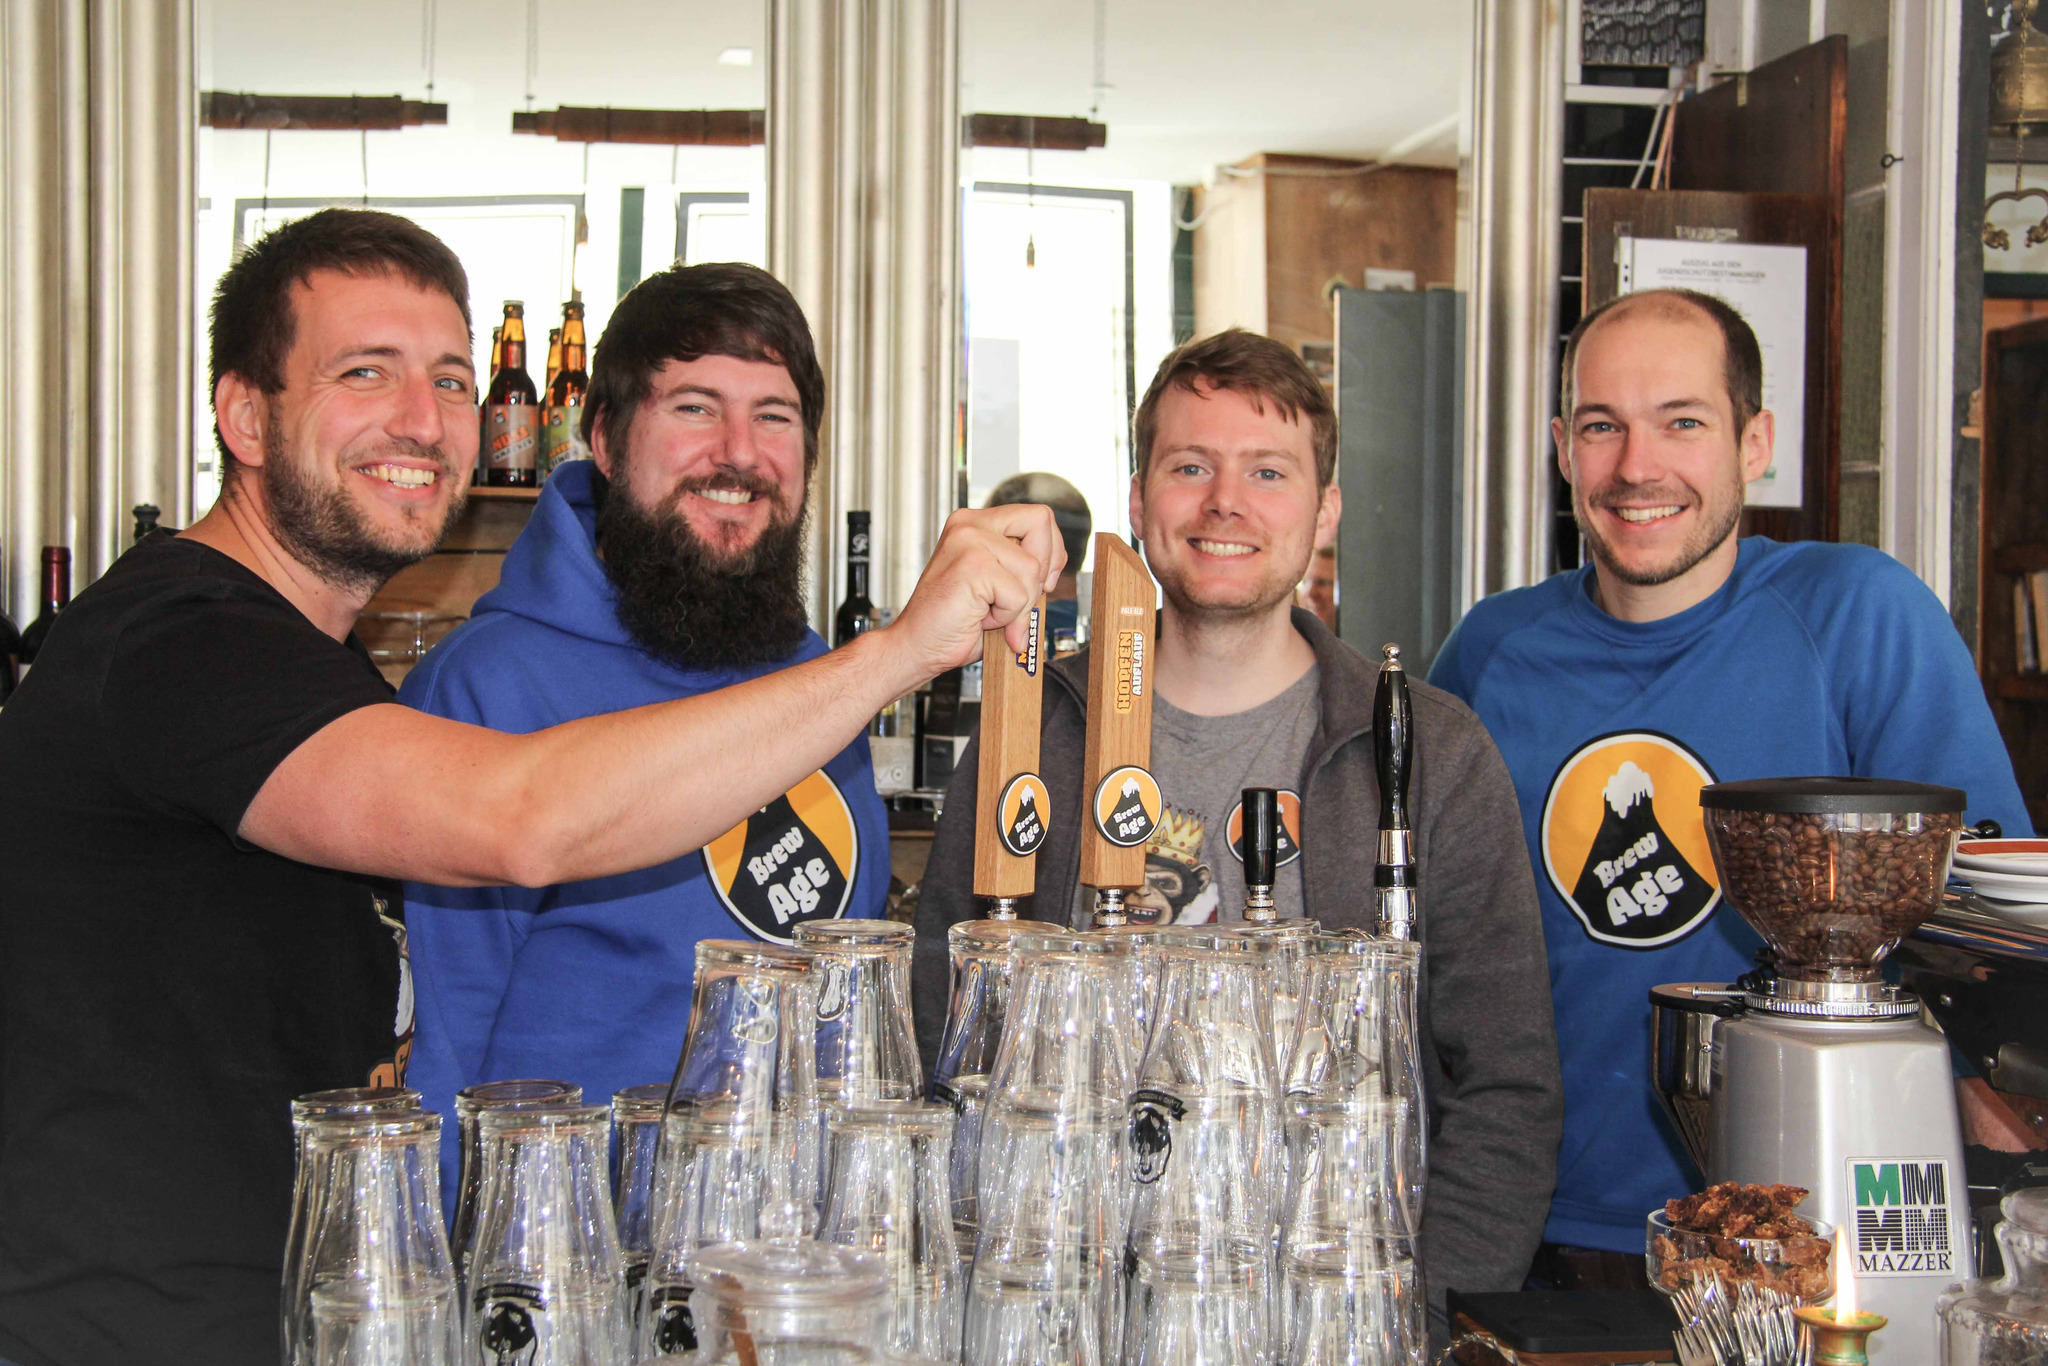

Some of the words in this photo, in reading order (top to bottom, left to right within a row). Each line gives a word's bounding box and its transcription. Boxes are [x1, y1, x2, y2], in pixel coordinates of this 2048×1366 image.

[1120, 607, 1134, 615] PALE
[1027, 611, 1038, 673] STRASSE
[1117, 631, 1132, 710] HOPFEN
[1132, 632, 1144, 696] AUFLAUF
[1014, 811, 1036, 833] Brew
[1019, 822, 1040, 847] Age
[1113, 803, 1141, 824] Brew
[1118, 816, 1146, 838] Age
[747, 826, 804, 886] Brew
[1593, 831, 1659, 889] Brew
[767, 857, 831, 925] Age
[1606, 864, 1684, 927] Age
[1858, 1252, 1951, 1272] MAZZER
